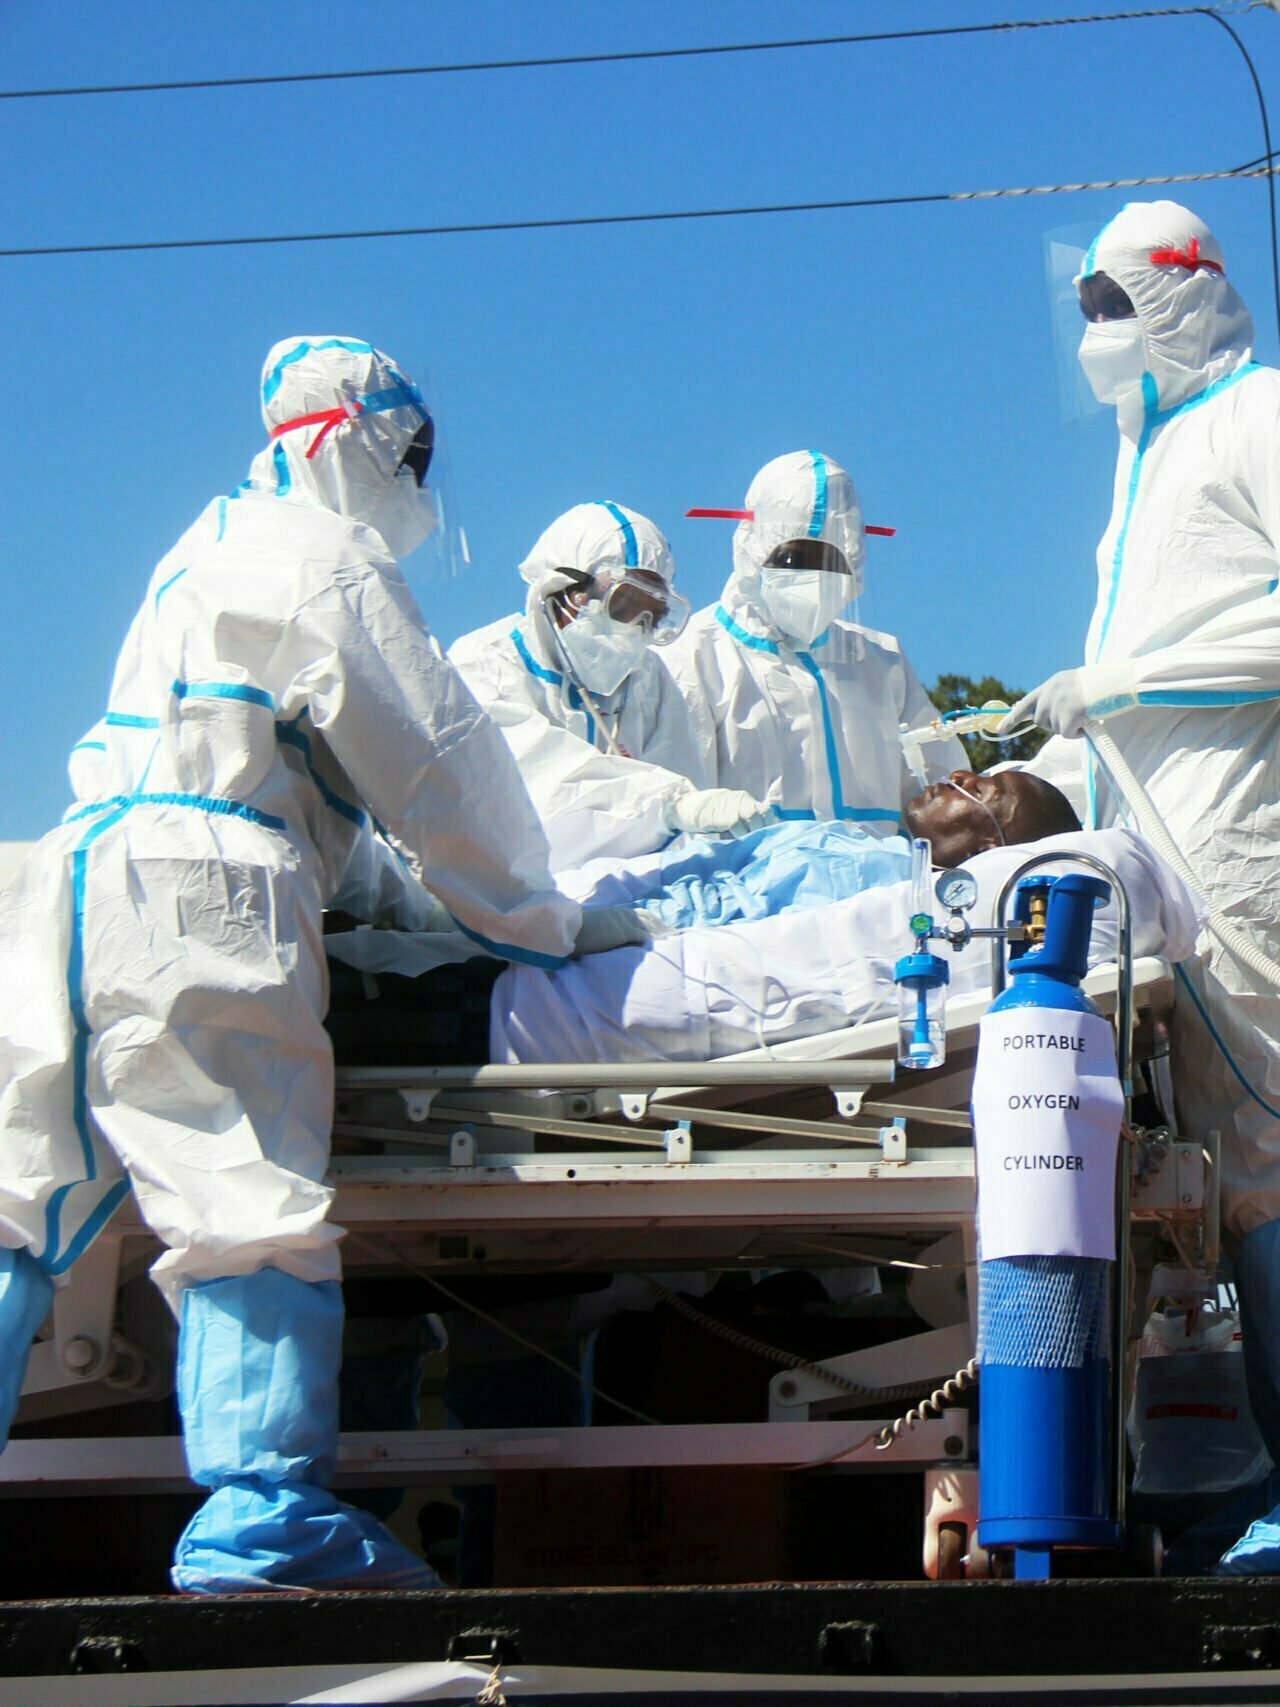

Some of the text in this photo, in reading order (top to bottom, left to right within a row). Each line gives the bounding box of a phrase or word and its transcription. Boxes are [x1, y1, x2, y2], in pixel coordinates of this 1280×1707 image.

[1003, 1034, 1086, 1052] PORTABLE
[1008, 1094, 1080, 1110] OXYGEN
[1003, 1155, 1084, 1171] CYLINDER
[525, 1547, 593, 1567] STORE
